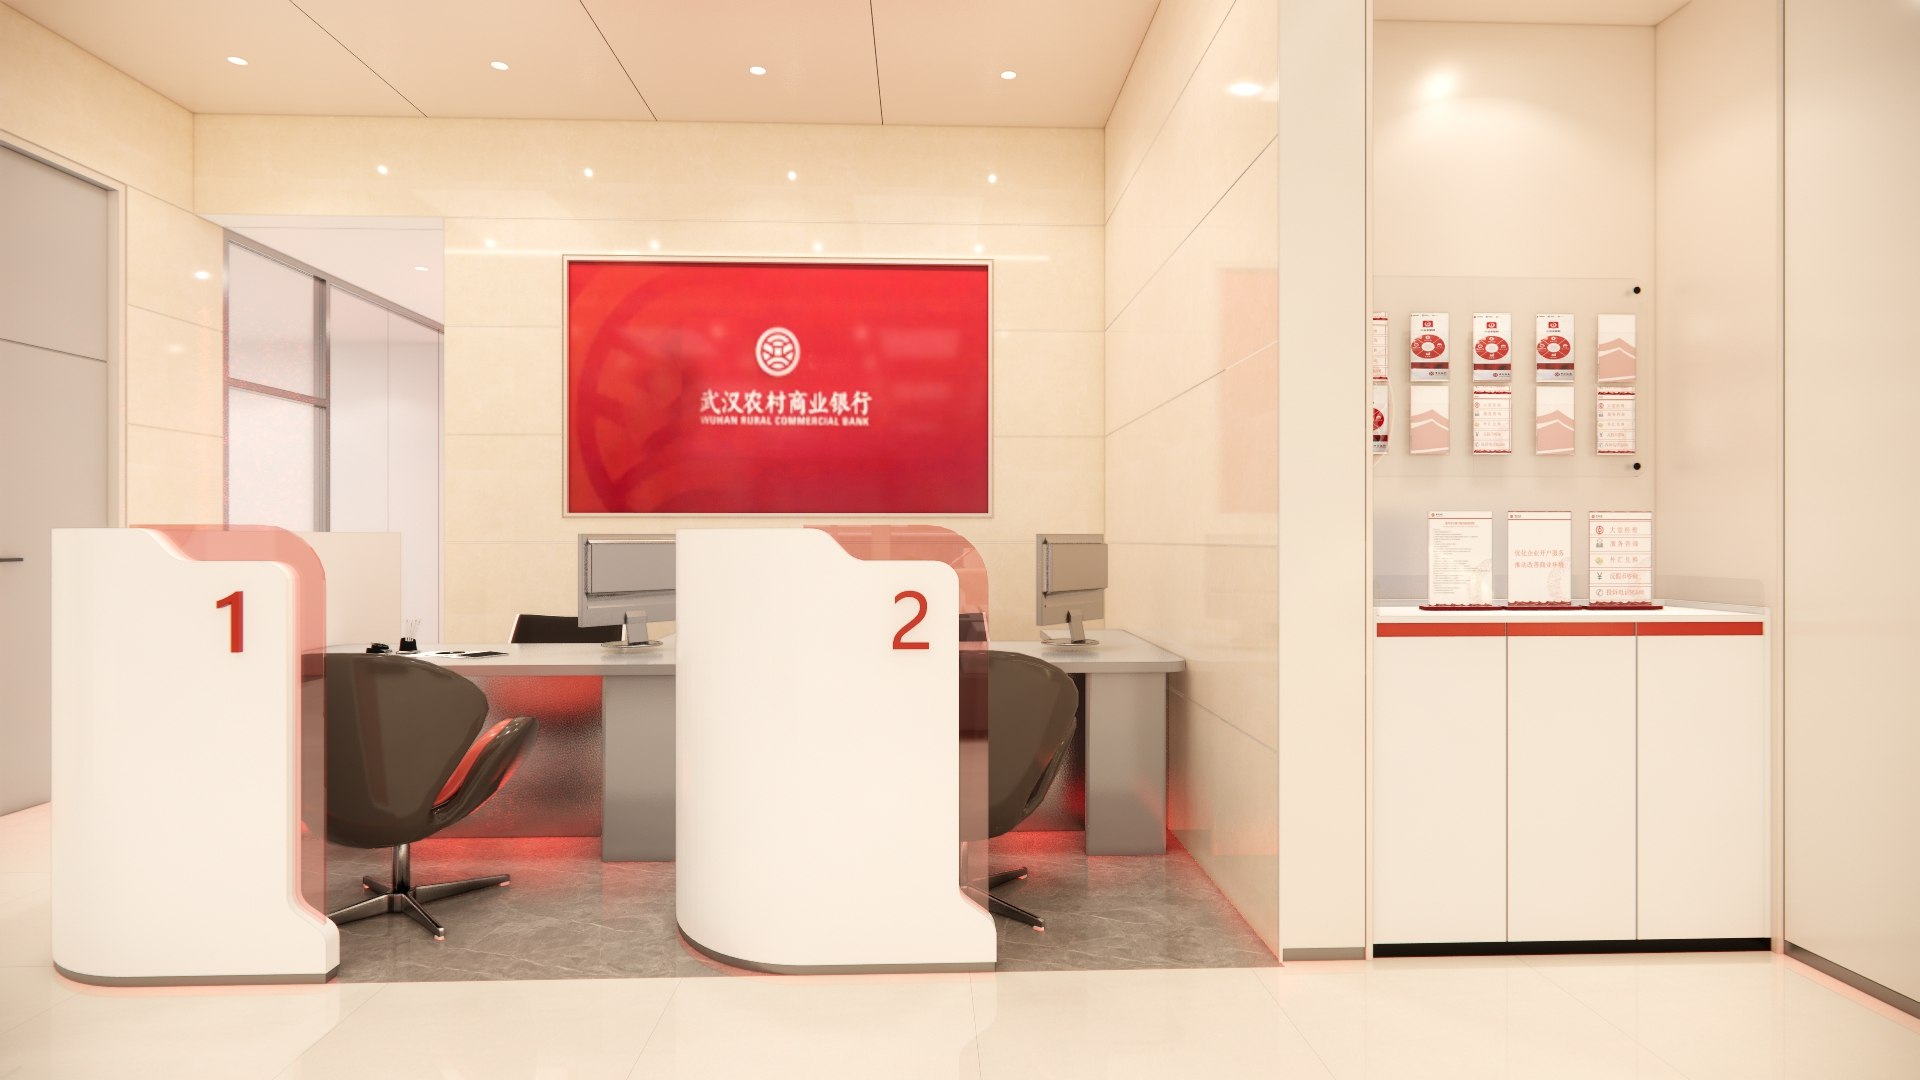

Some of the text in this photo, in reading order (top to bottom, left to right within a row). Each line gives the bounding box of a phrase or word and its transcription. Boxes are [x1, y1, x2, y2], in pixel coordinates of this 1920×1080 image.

[700, 389, 872, 415] 武汉农村商业银行
[701, 416, 869, 426] WUHAN RURAL COMMERCIAL BANK
[216, 591, 244, 653] 1
[892, 590, 929, 650] 2
